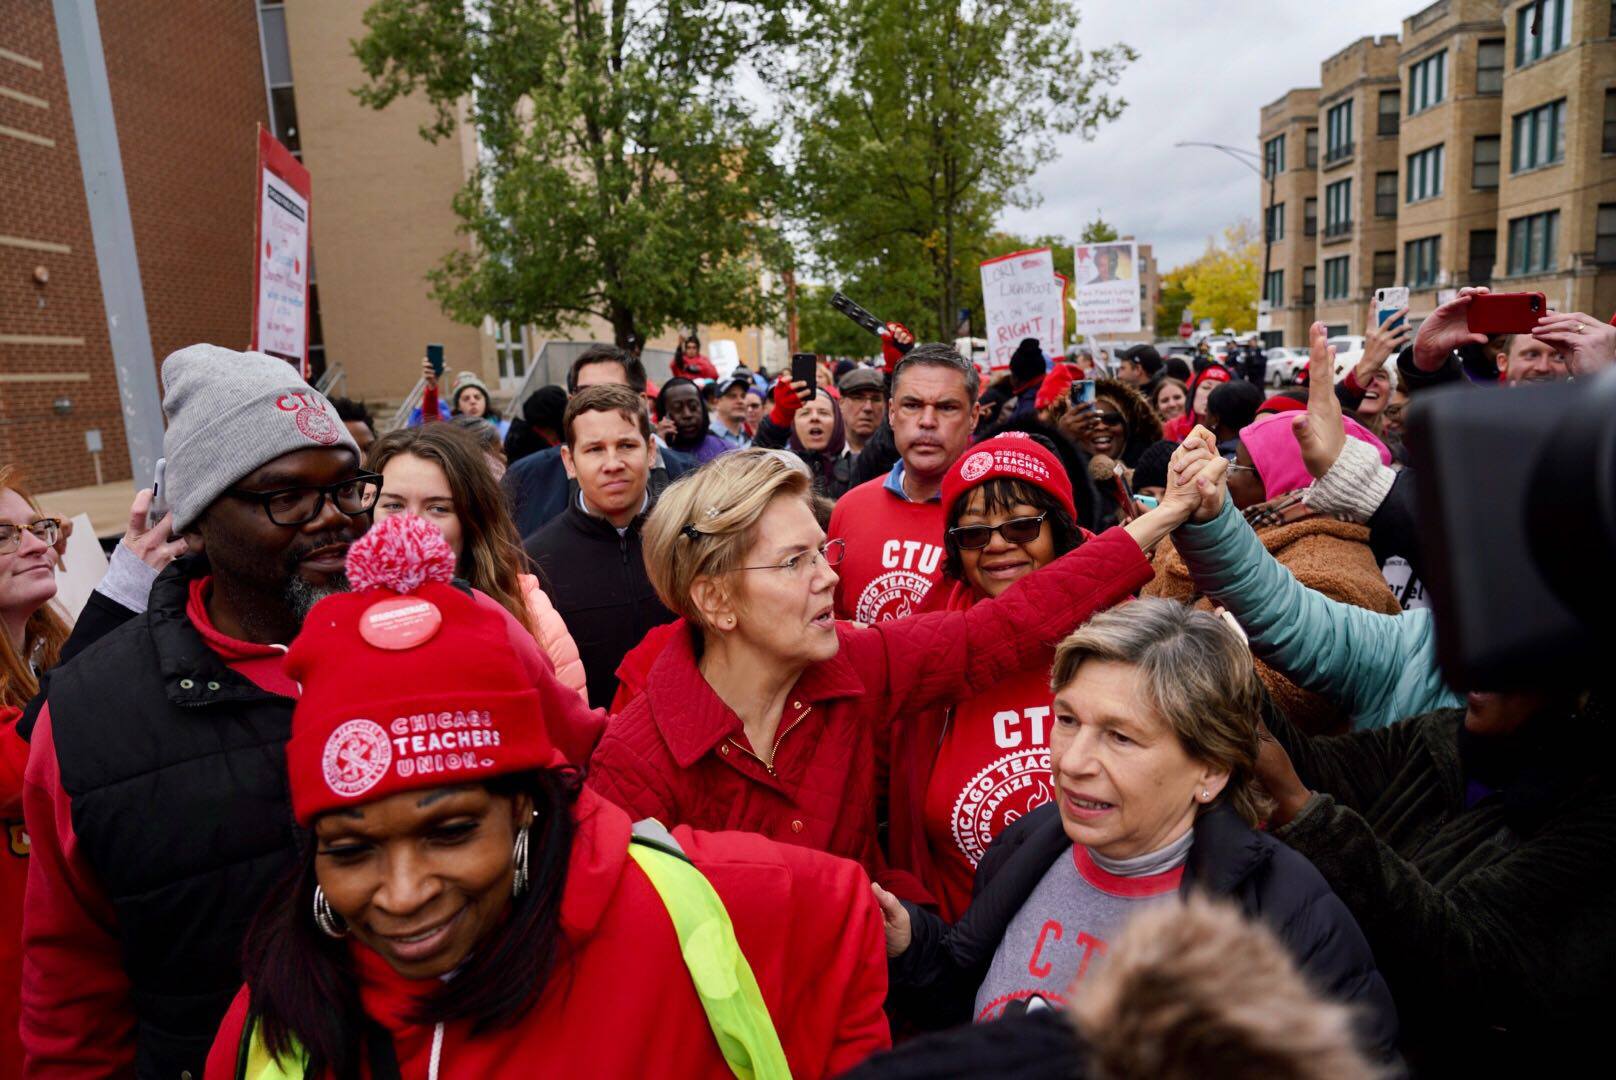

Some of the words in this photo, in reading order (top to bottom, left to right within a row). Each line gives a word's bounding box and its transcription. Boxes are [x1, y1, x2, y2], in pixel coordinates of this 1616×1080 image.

[997, 316, 1042, 343] RIGHT
[882, 539, 943, 574] CTU
[393, 730, 501, 756] TEACHERS
[993, 705, 1050, 749] CT
[997, 755, 1051, 778] TEAC
[979, 775, 1033, 844] ORGANIZE
[1028, 918, 1109, 996] CT
